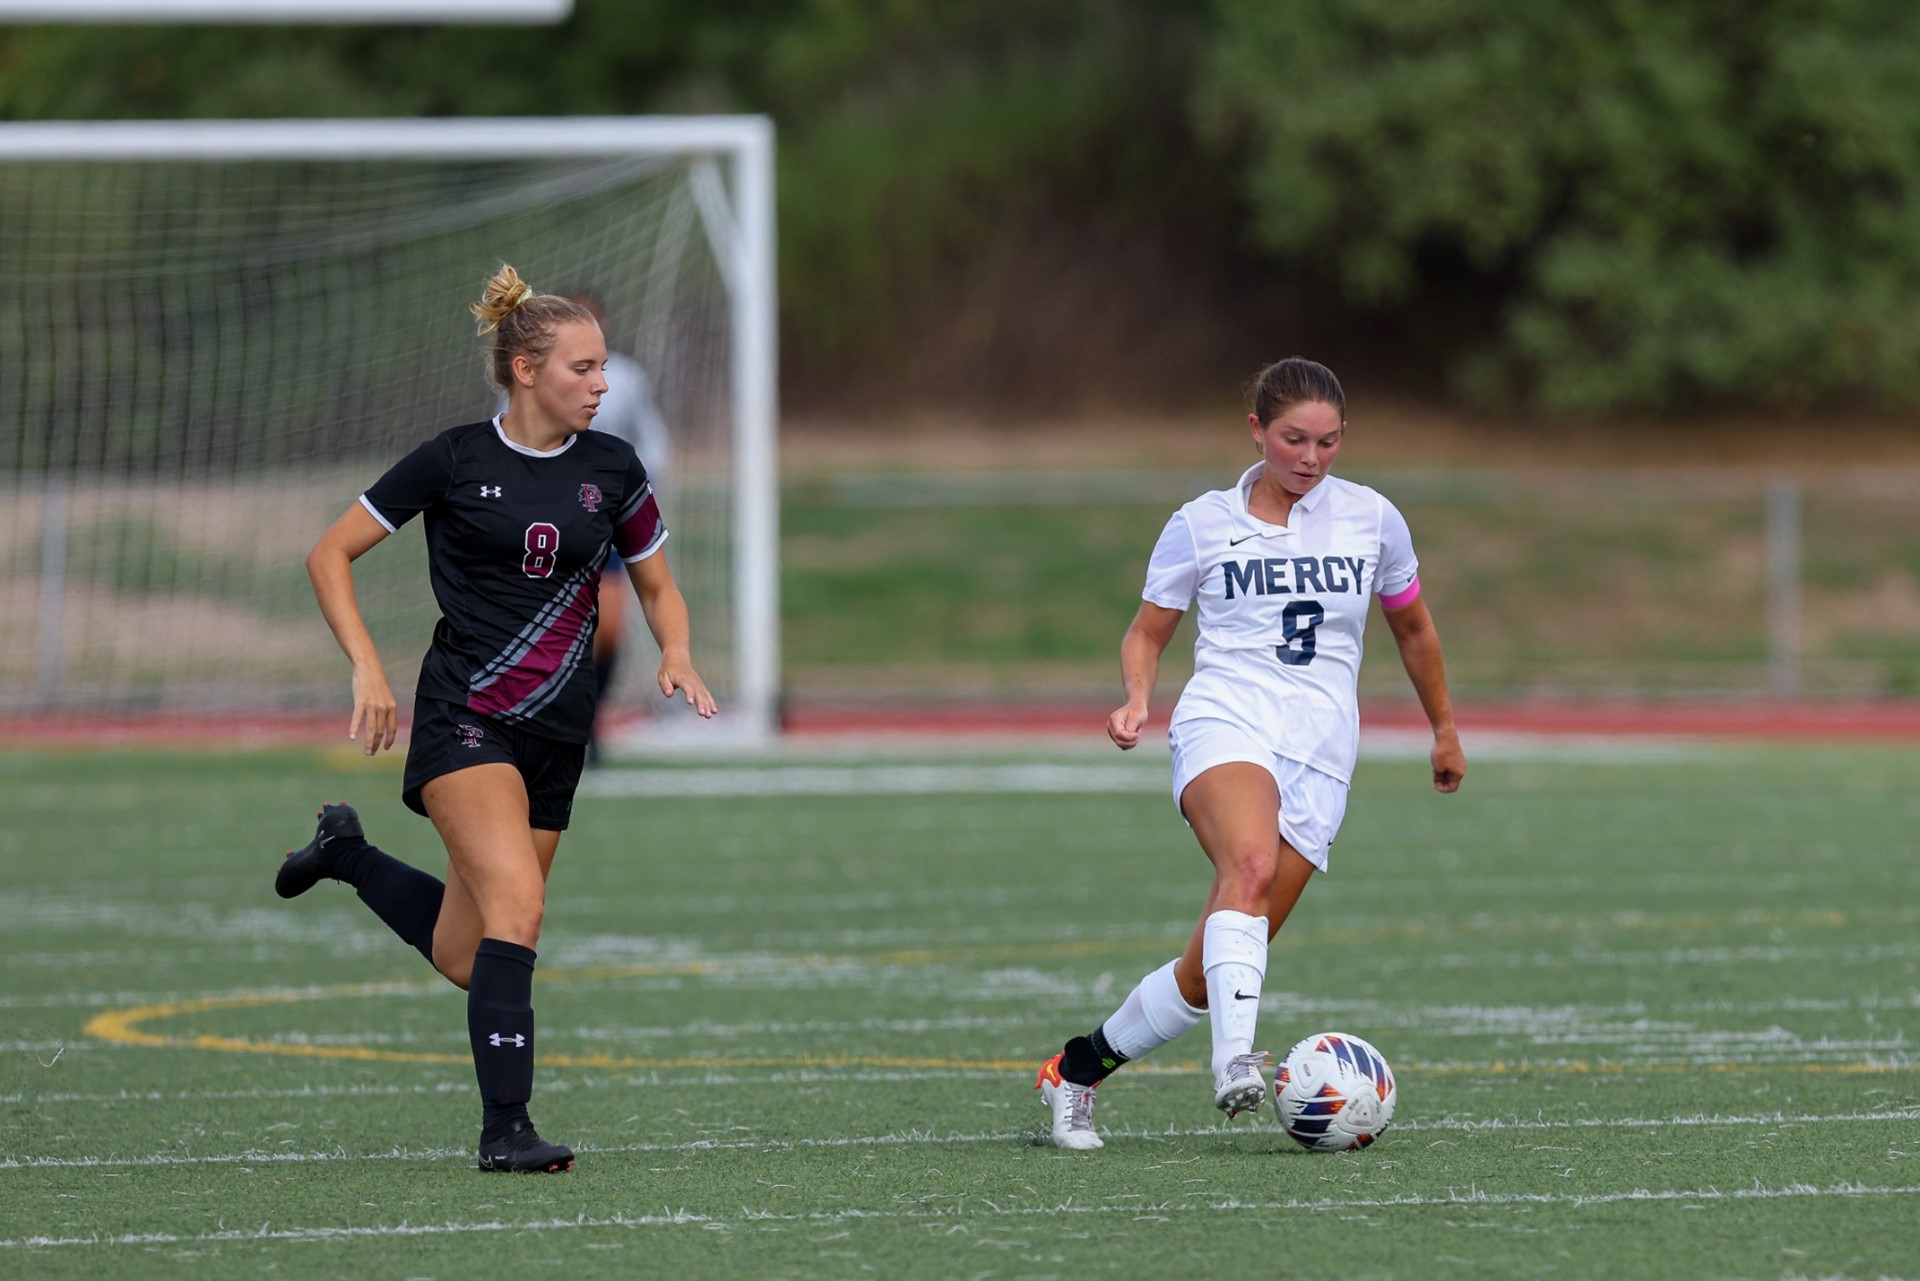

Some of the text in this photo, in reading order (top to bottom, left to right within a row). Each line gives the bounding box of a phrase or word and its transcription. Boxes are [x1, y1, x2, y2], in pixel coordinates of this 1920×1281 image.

[522, 522, 560, 578] 8
[1221, 556, 1366, 600] MERCY
[1275, 600, 1325, 666] 8
